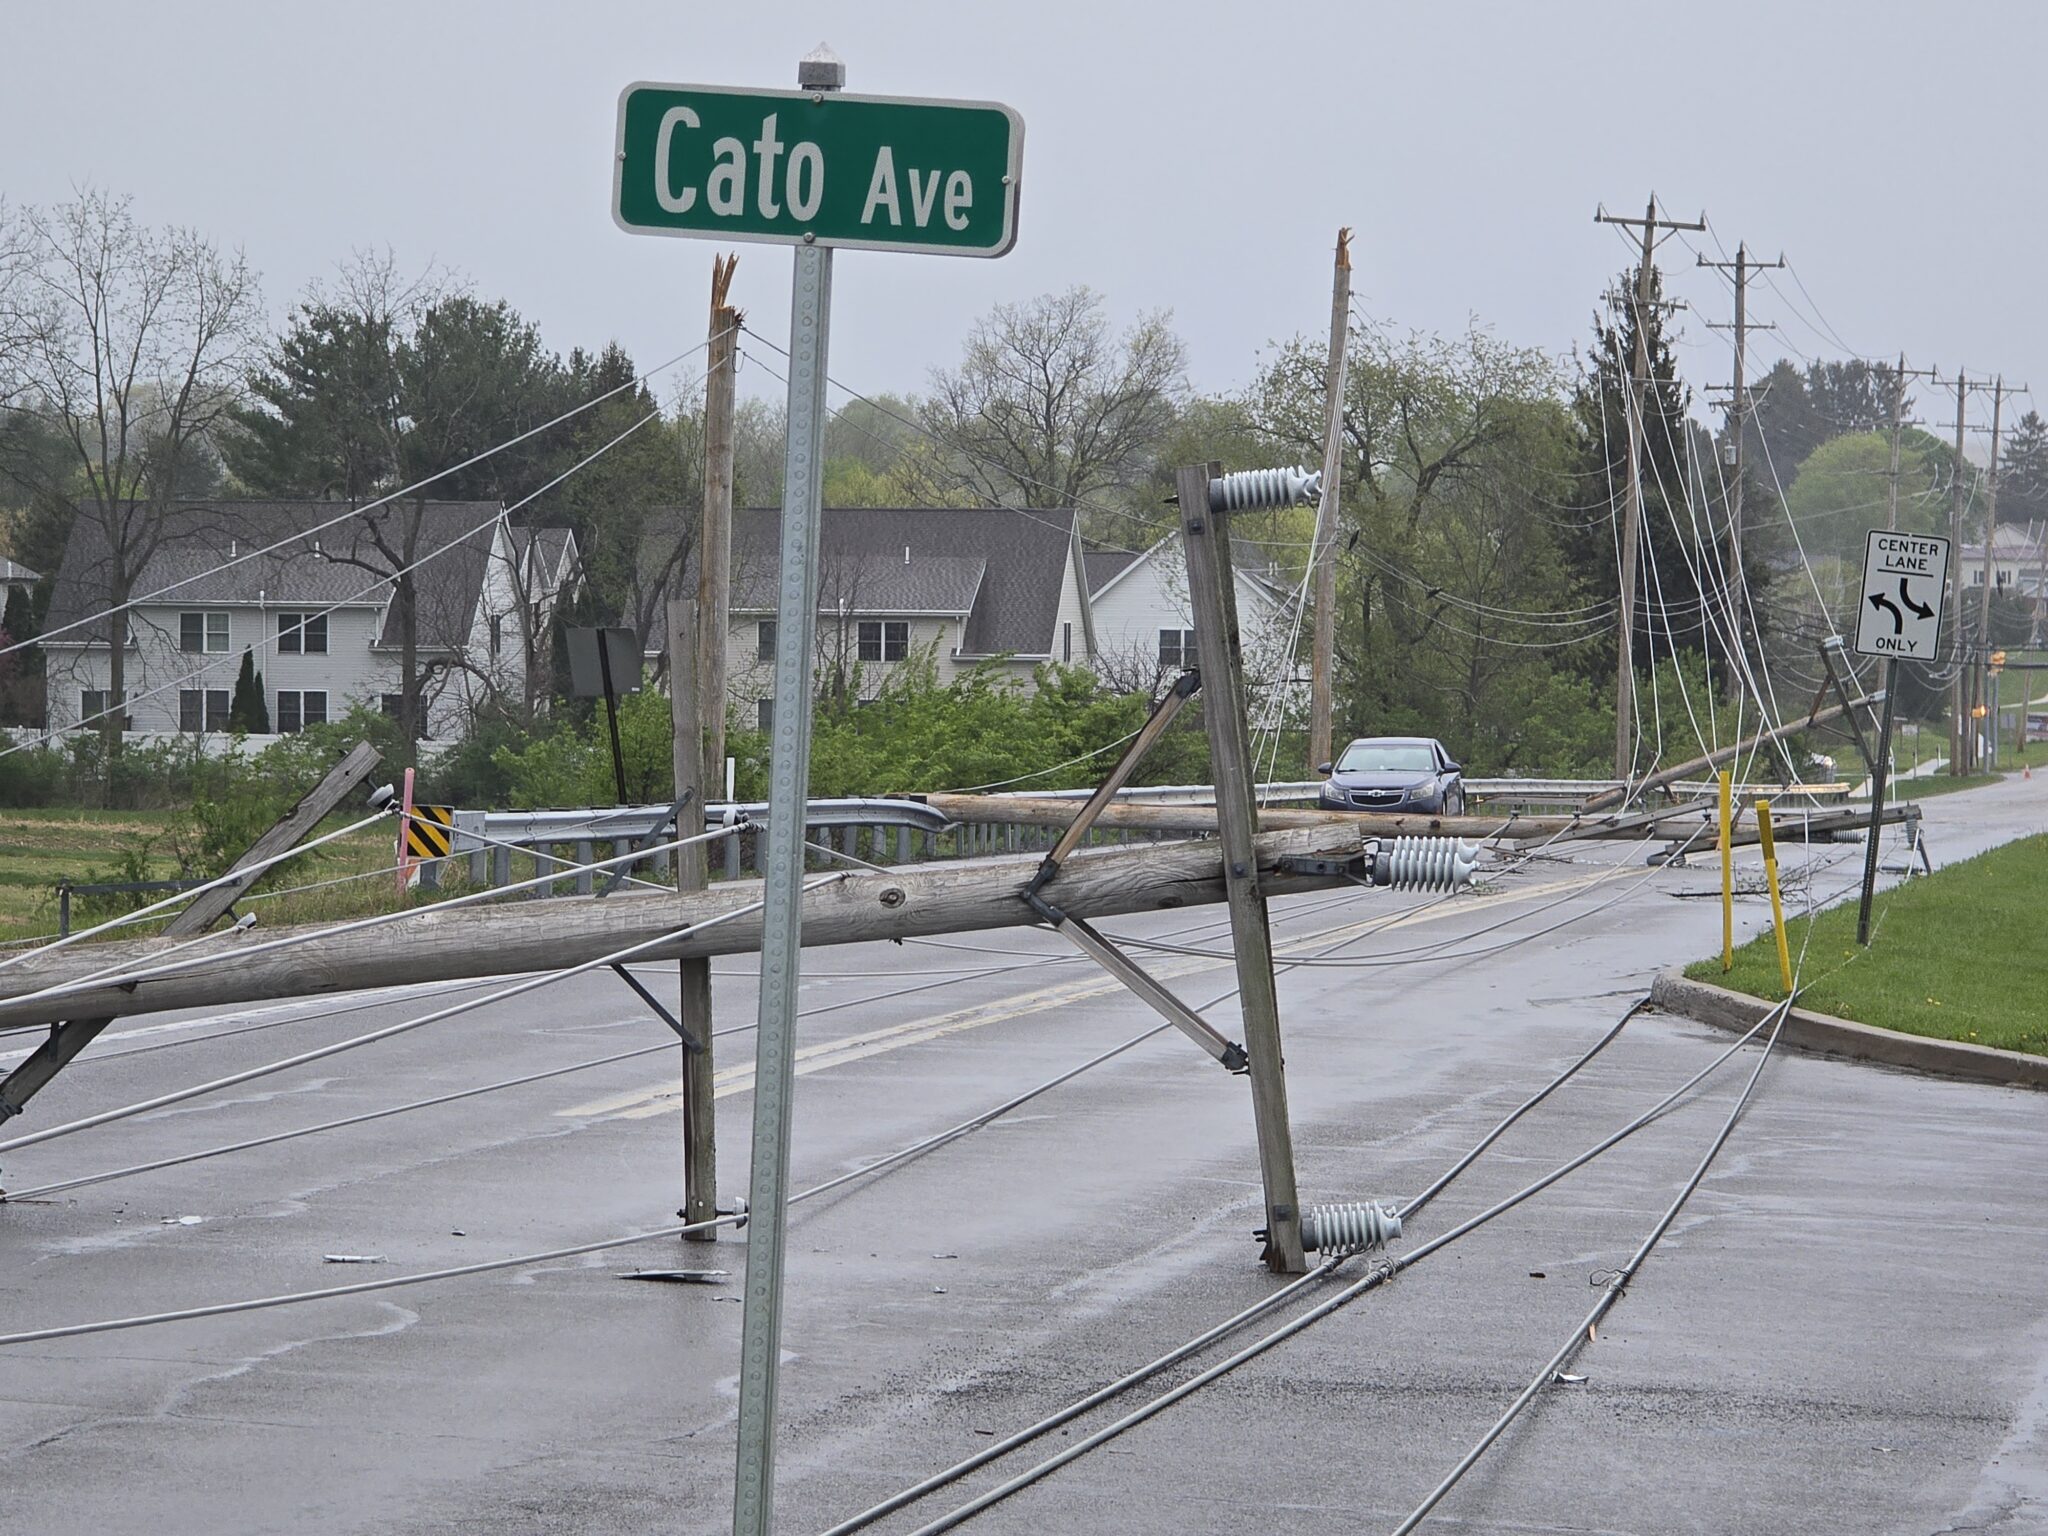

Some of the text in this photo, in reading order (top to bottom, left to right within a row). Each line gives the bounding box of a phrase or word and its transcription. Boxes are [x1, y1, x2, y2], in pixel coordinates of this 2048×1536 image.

[655, 106, 973, 231] Cato Ave
[1878, 538, 1939, 556] CENTER
[1885, 554, 1928, 570] LANE
[1876, 637, 1917, 652] ONLY
